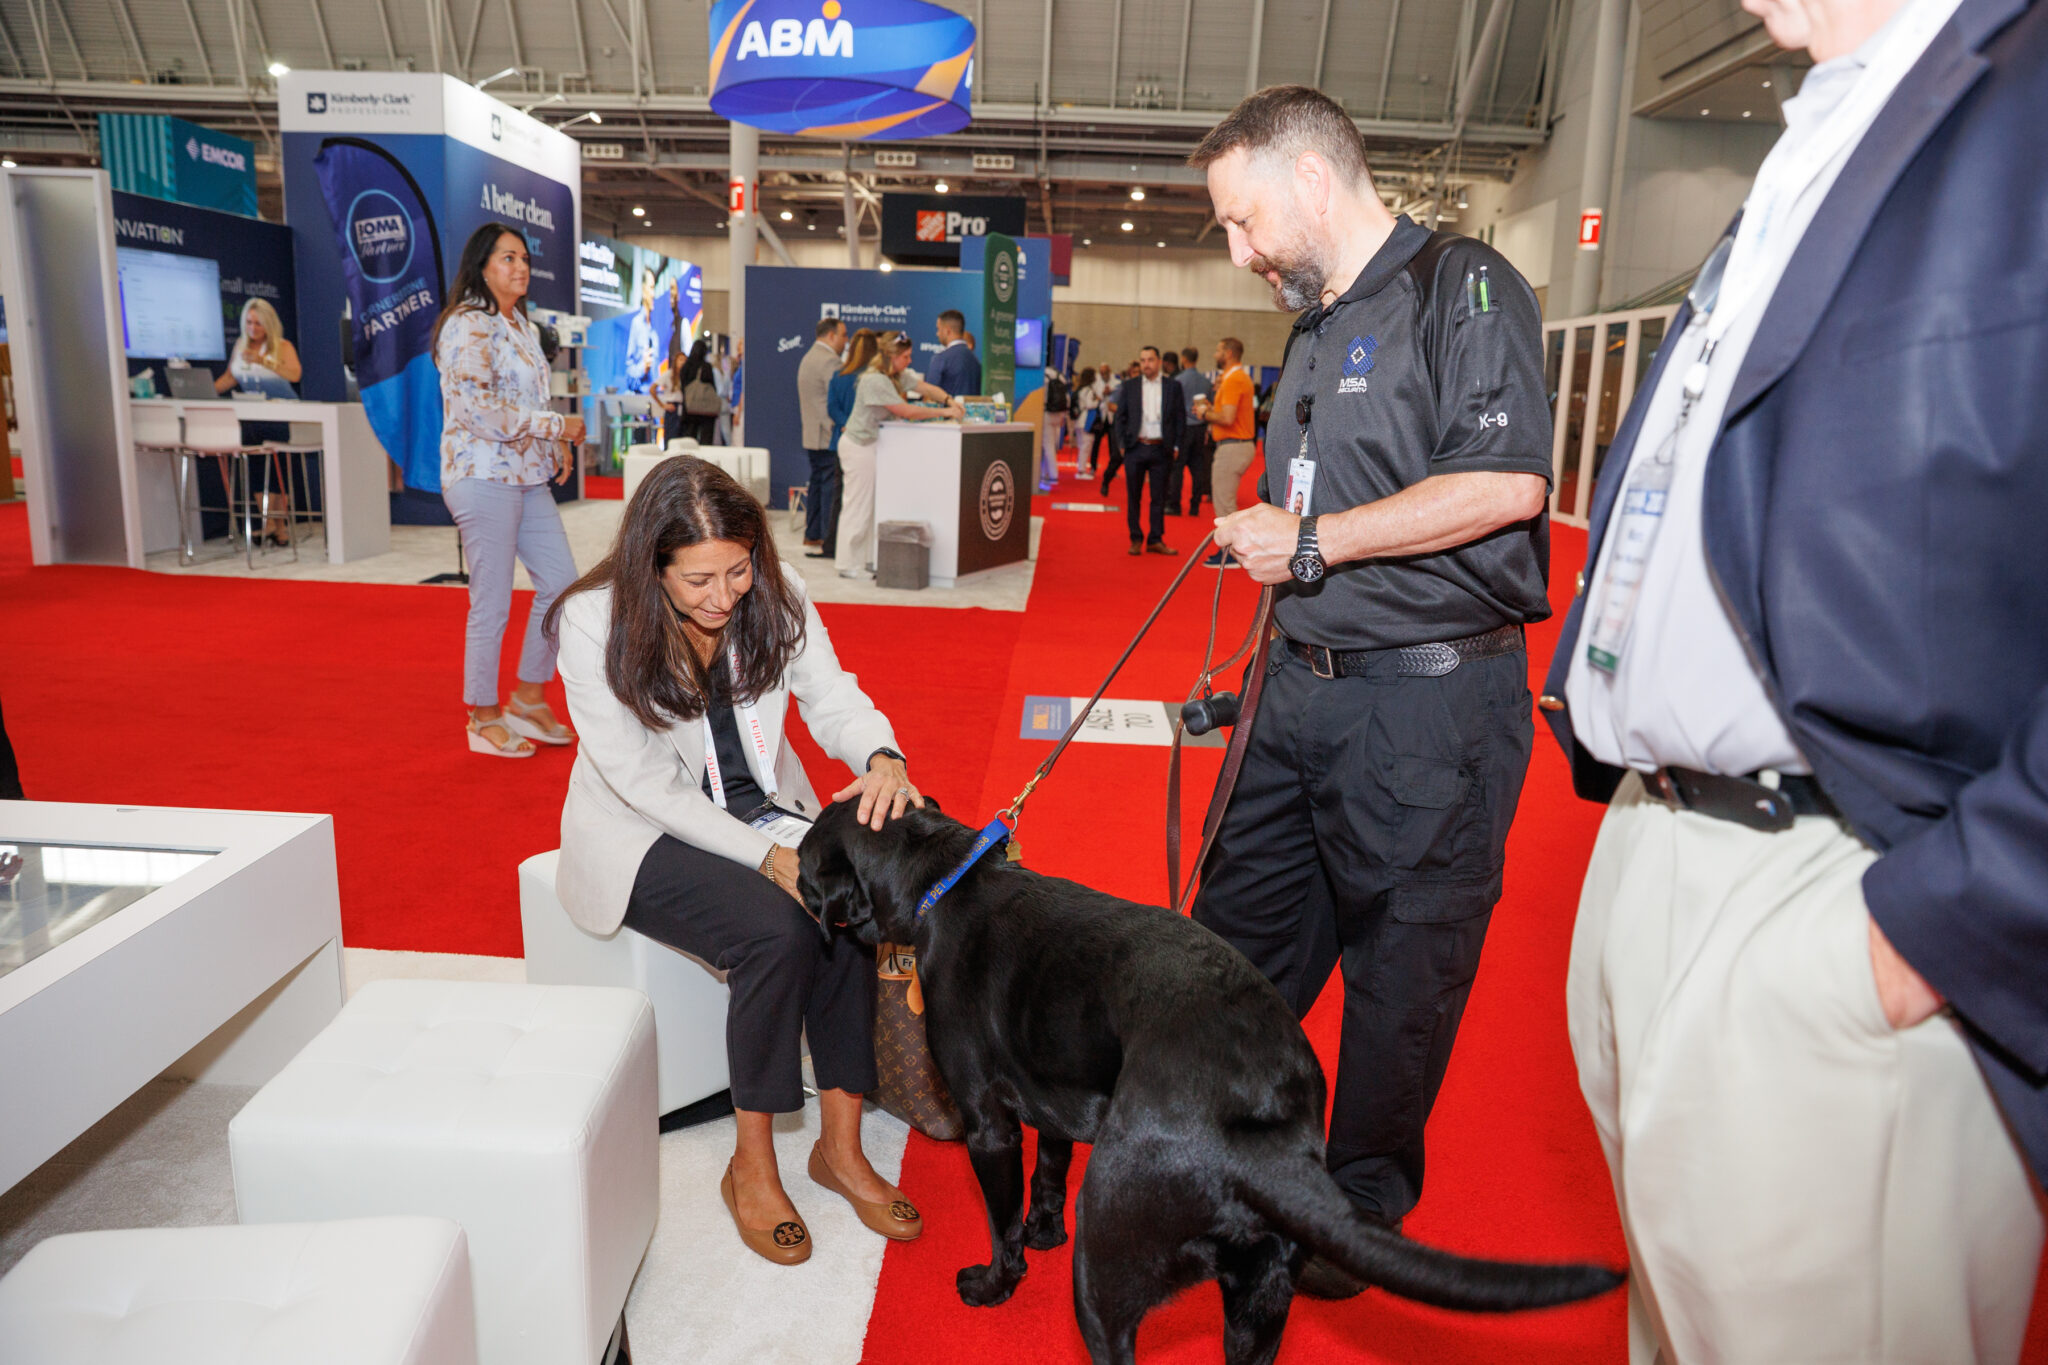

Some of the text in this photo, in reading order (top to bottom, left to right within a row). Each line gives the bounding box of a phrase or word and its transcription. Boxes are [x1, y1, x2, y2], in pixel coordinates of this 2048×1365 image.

[737, 19, 853, 60] ABM
[201, 143, 246, 172] EMCOR
[480, 183, 556, 232] A better clean.
[946, 211, 987, 236] Pro
[220, 277, 243, 293] mall
[364, 290, 434, 340] PARTNER
[841, 304, 907, 316] Kimberly-Clark
[1340, 377, 1368, 388] MSA
[1478, 412, 1509, 431] K-9
[750, 719, 767, 755] FUJITEC
[705, 753, 720, 792] FUJITEC
[930, 882, 947, 900] PET
